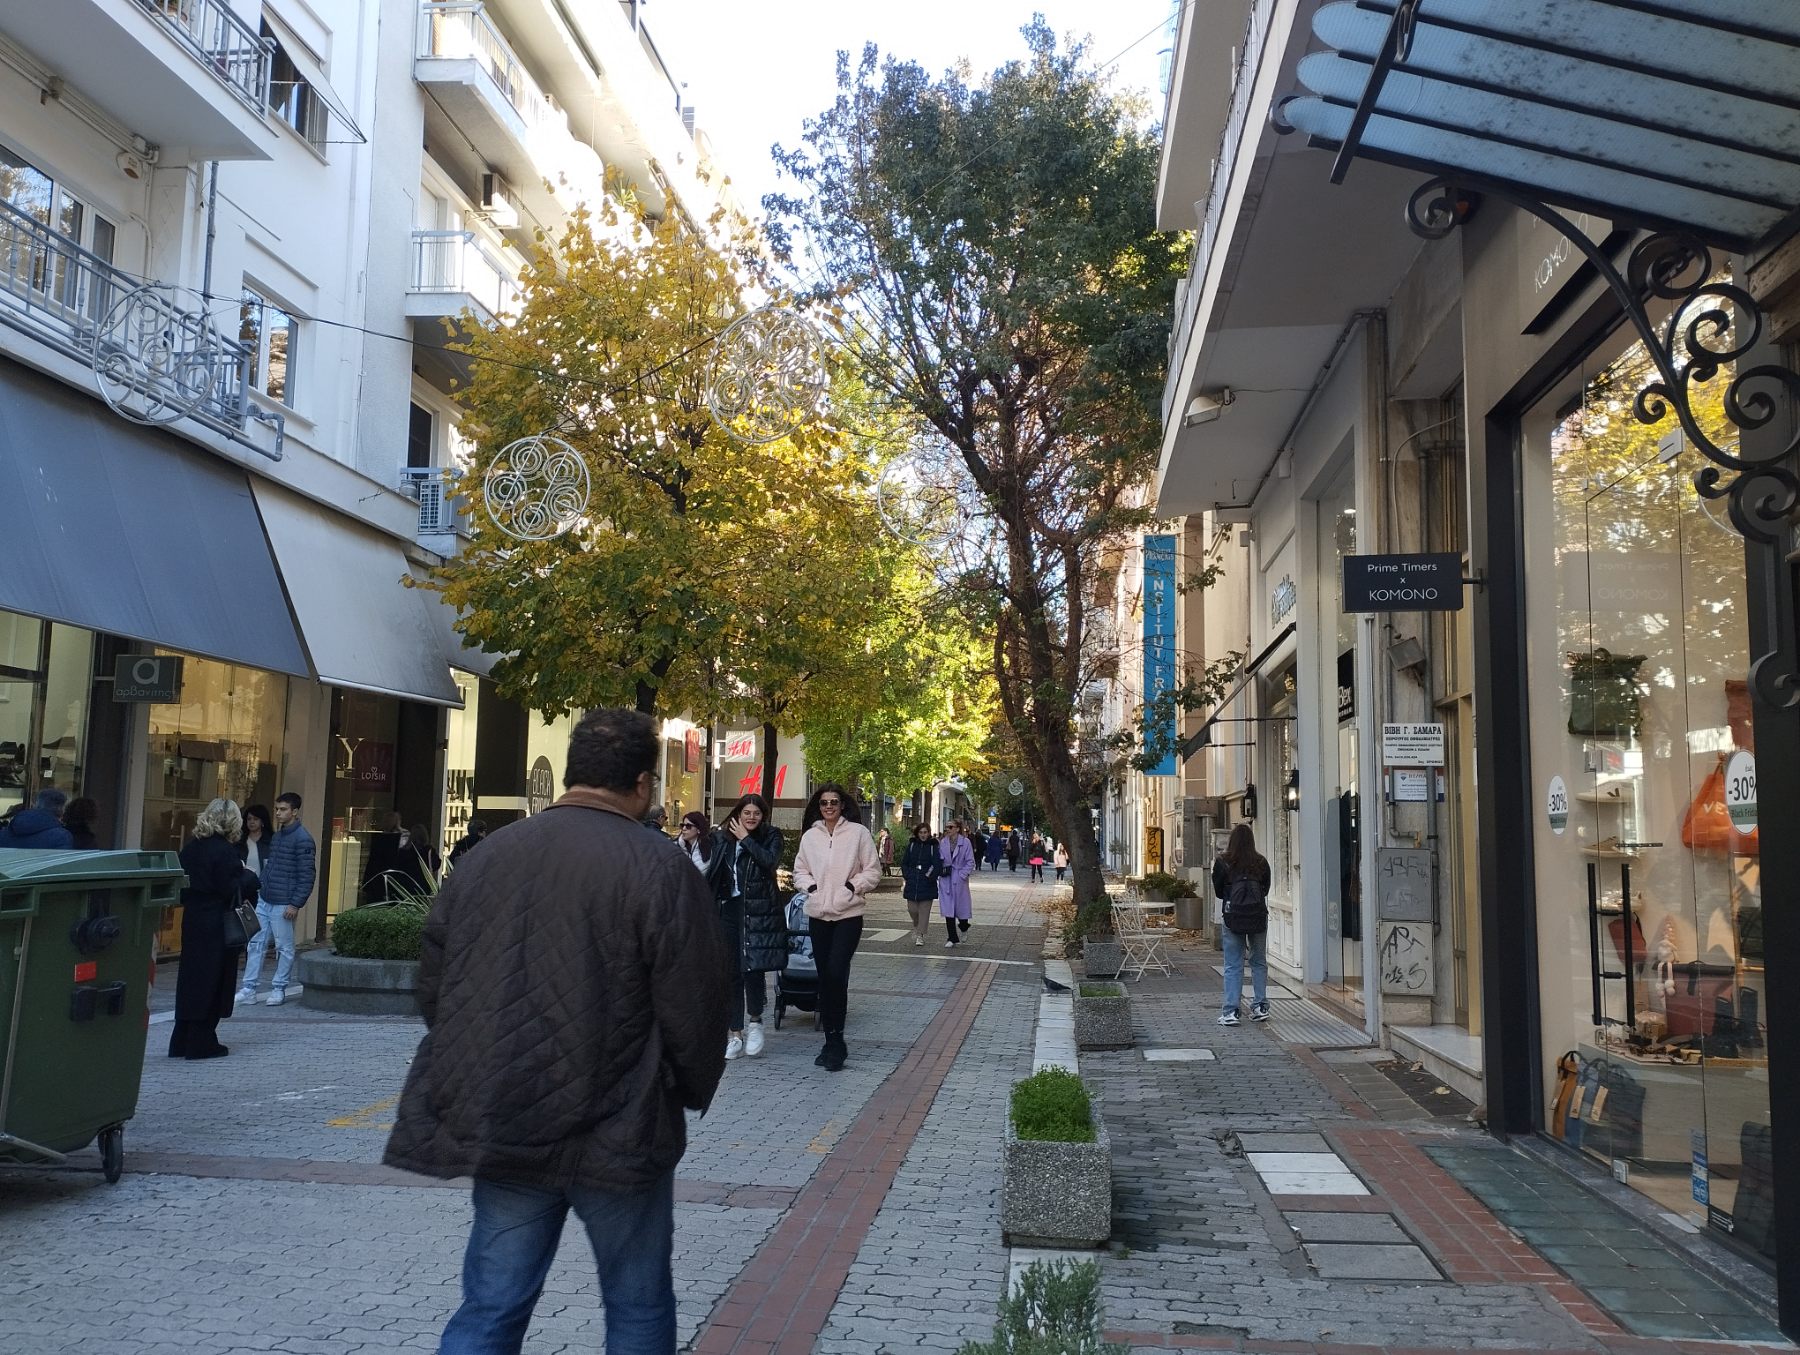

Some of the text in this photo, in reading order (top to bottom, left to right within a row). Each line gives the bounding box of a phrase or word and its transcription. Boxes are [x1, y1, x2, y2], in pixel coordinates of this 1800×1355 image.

[1367, 562, 1438, 573] Prime Timers
[1369, 587, 1438, 601] KOMONO
[727, 740, 752, 757] H&M
[361, 772, 386, 781] LOISIR
[532, 768, 552, 796] BLACK
[1548, 793, 1567, 812] -30%
